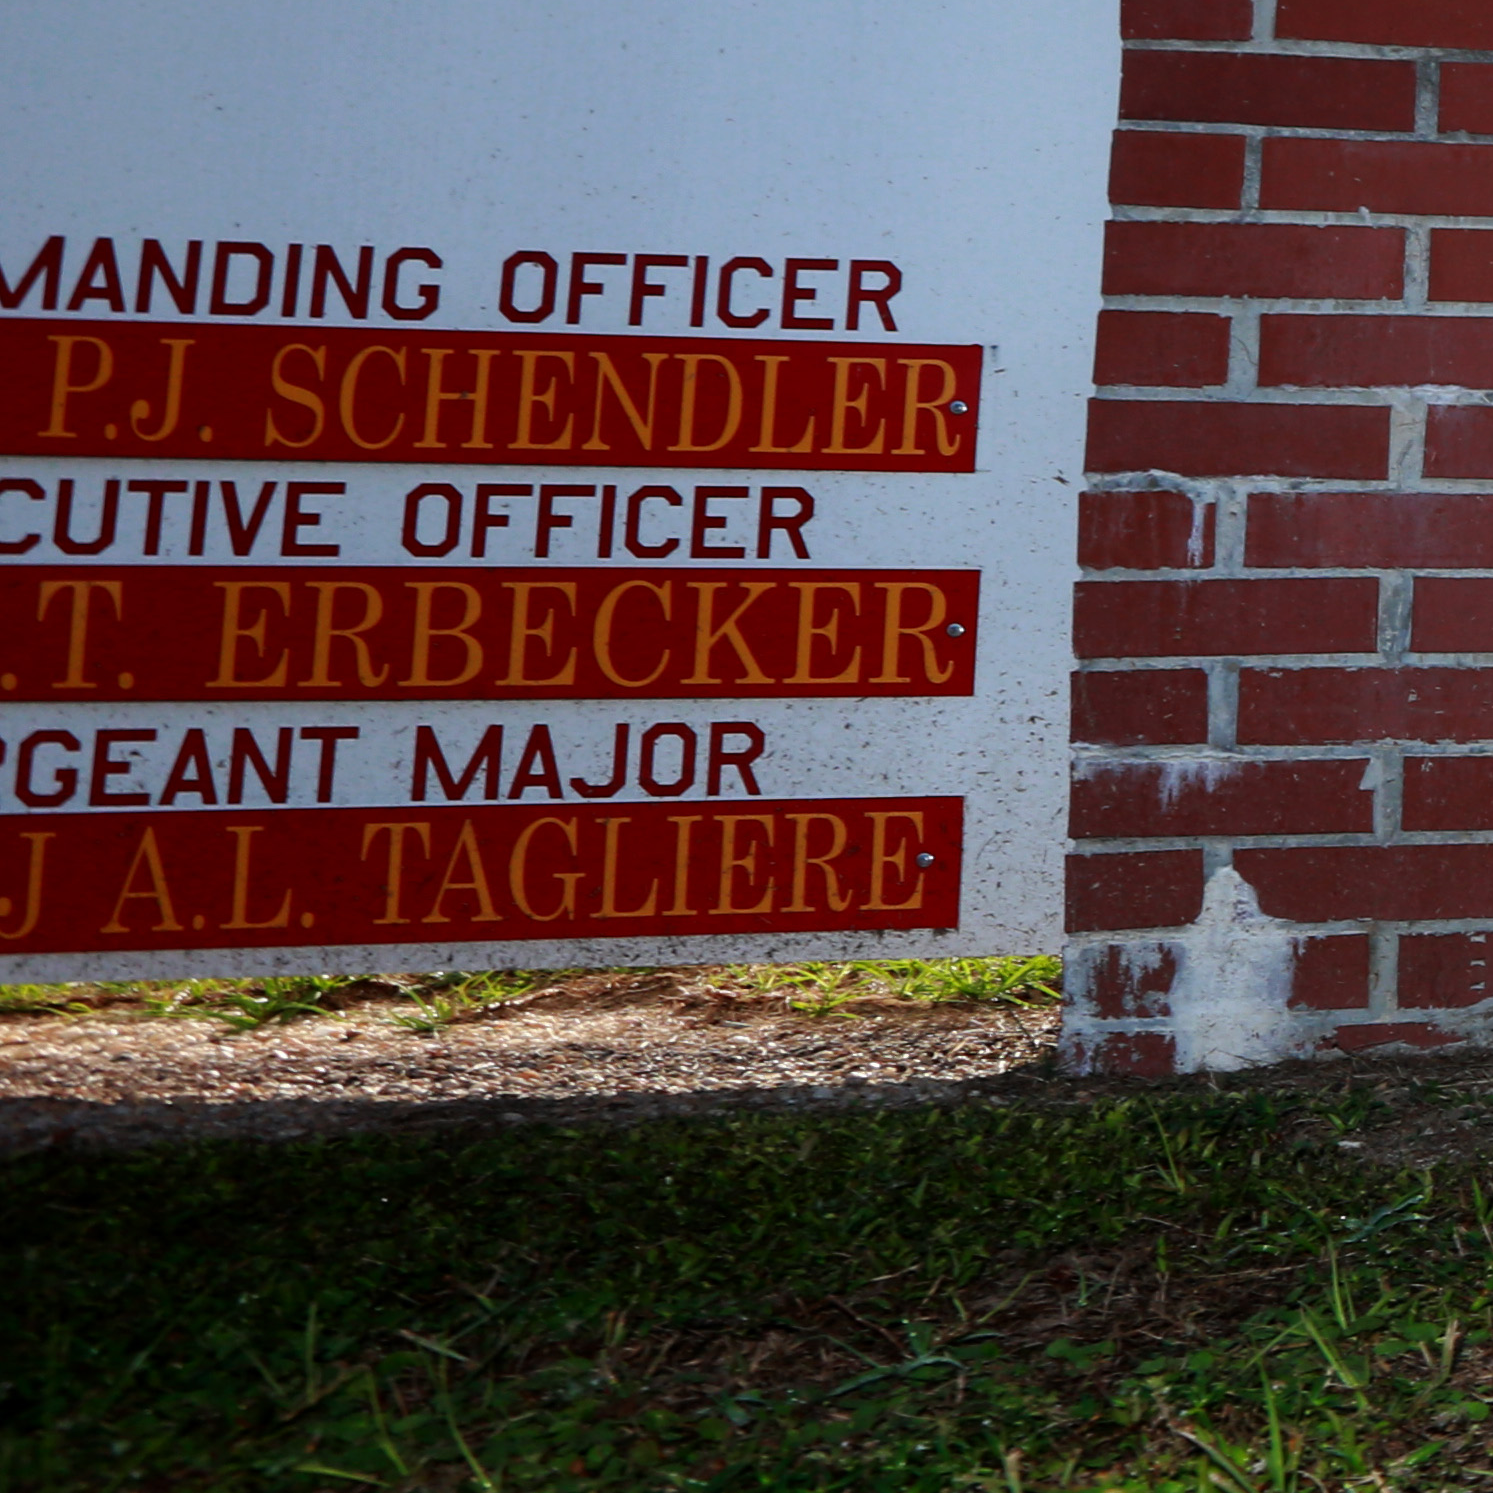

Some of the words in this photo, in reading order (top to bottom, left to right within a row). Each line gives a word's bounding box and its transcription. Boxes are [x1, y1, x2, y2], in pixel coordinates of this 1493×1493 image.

[499, 251, 901, 332] OFFICER
[37, 335, 213, 442] P.J.
[265, 344, 960, 455] SCHENDLER
[402, 483, 814, 559] OFFICER
[205, 580, 953, 688] ERBECKER
[0, 726, 359, 808] GEANT
[411, 722, 765, 802] MAJOR
[100, 825, 314, 933] A.L.
[361, 811, 924, 924] TAGLIERE
